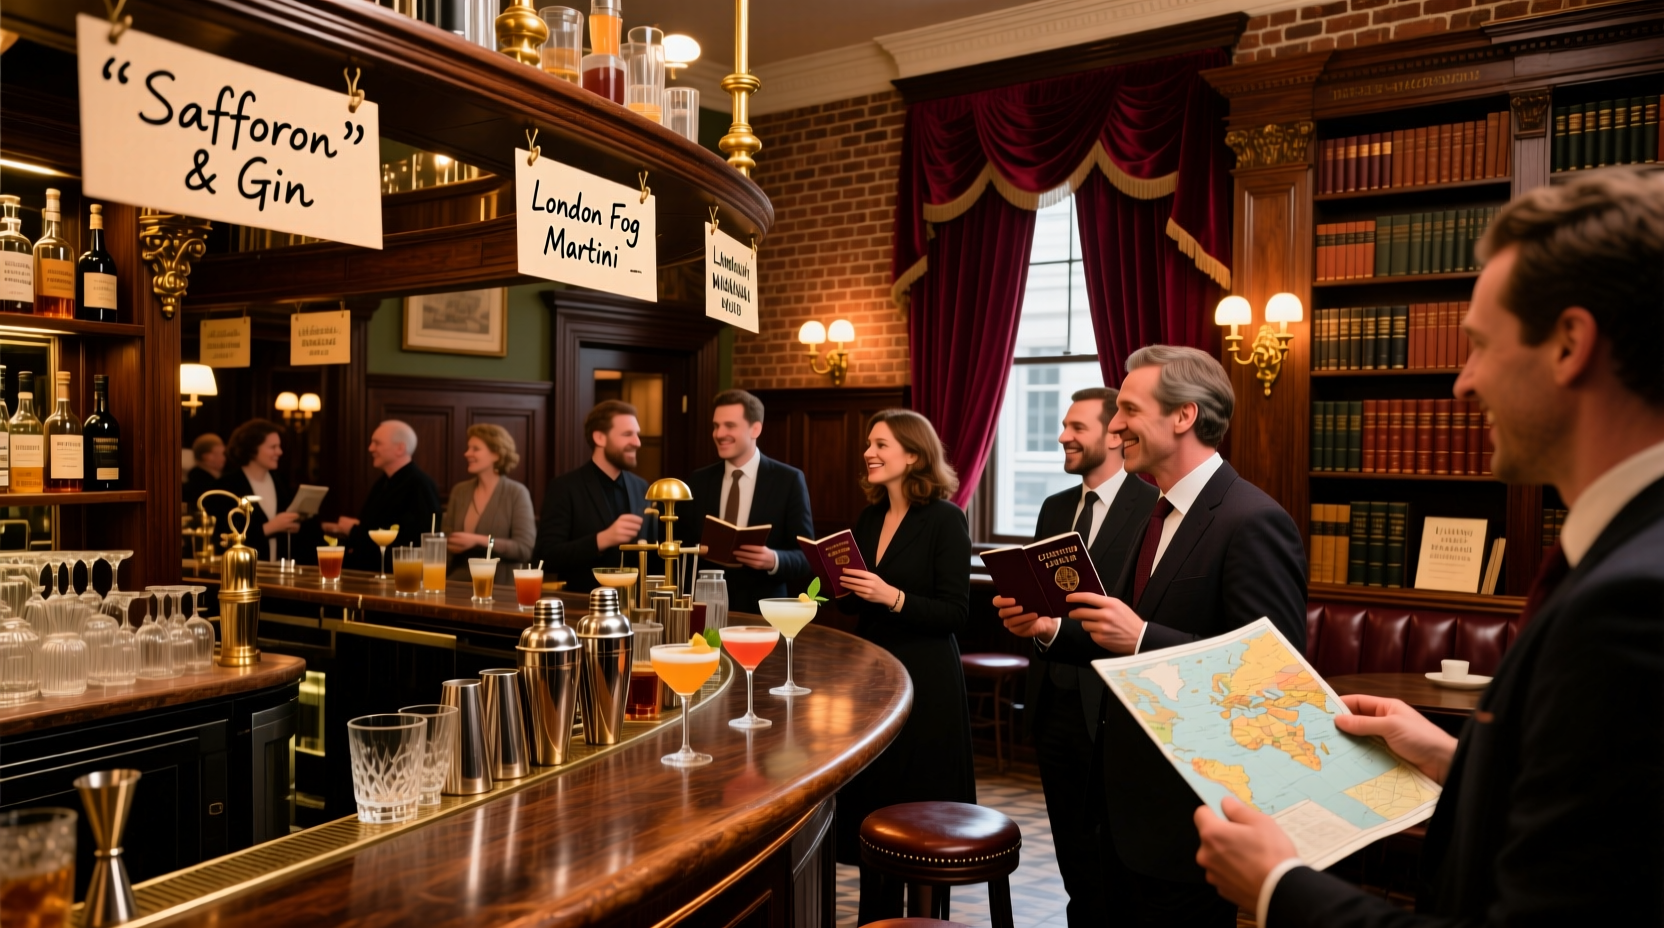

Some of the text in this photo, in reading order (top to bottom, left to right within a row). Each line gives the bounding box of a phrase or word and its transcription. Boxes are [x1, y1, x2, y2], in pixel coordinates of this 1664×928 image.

[185, 149, 314, 212] & Gin
[532, 179, 640, 248] London Fog
[543, 225, 619, 269] Martini
